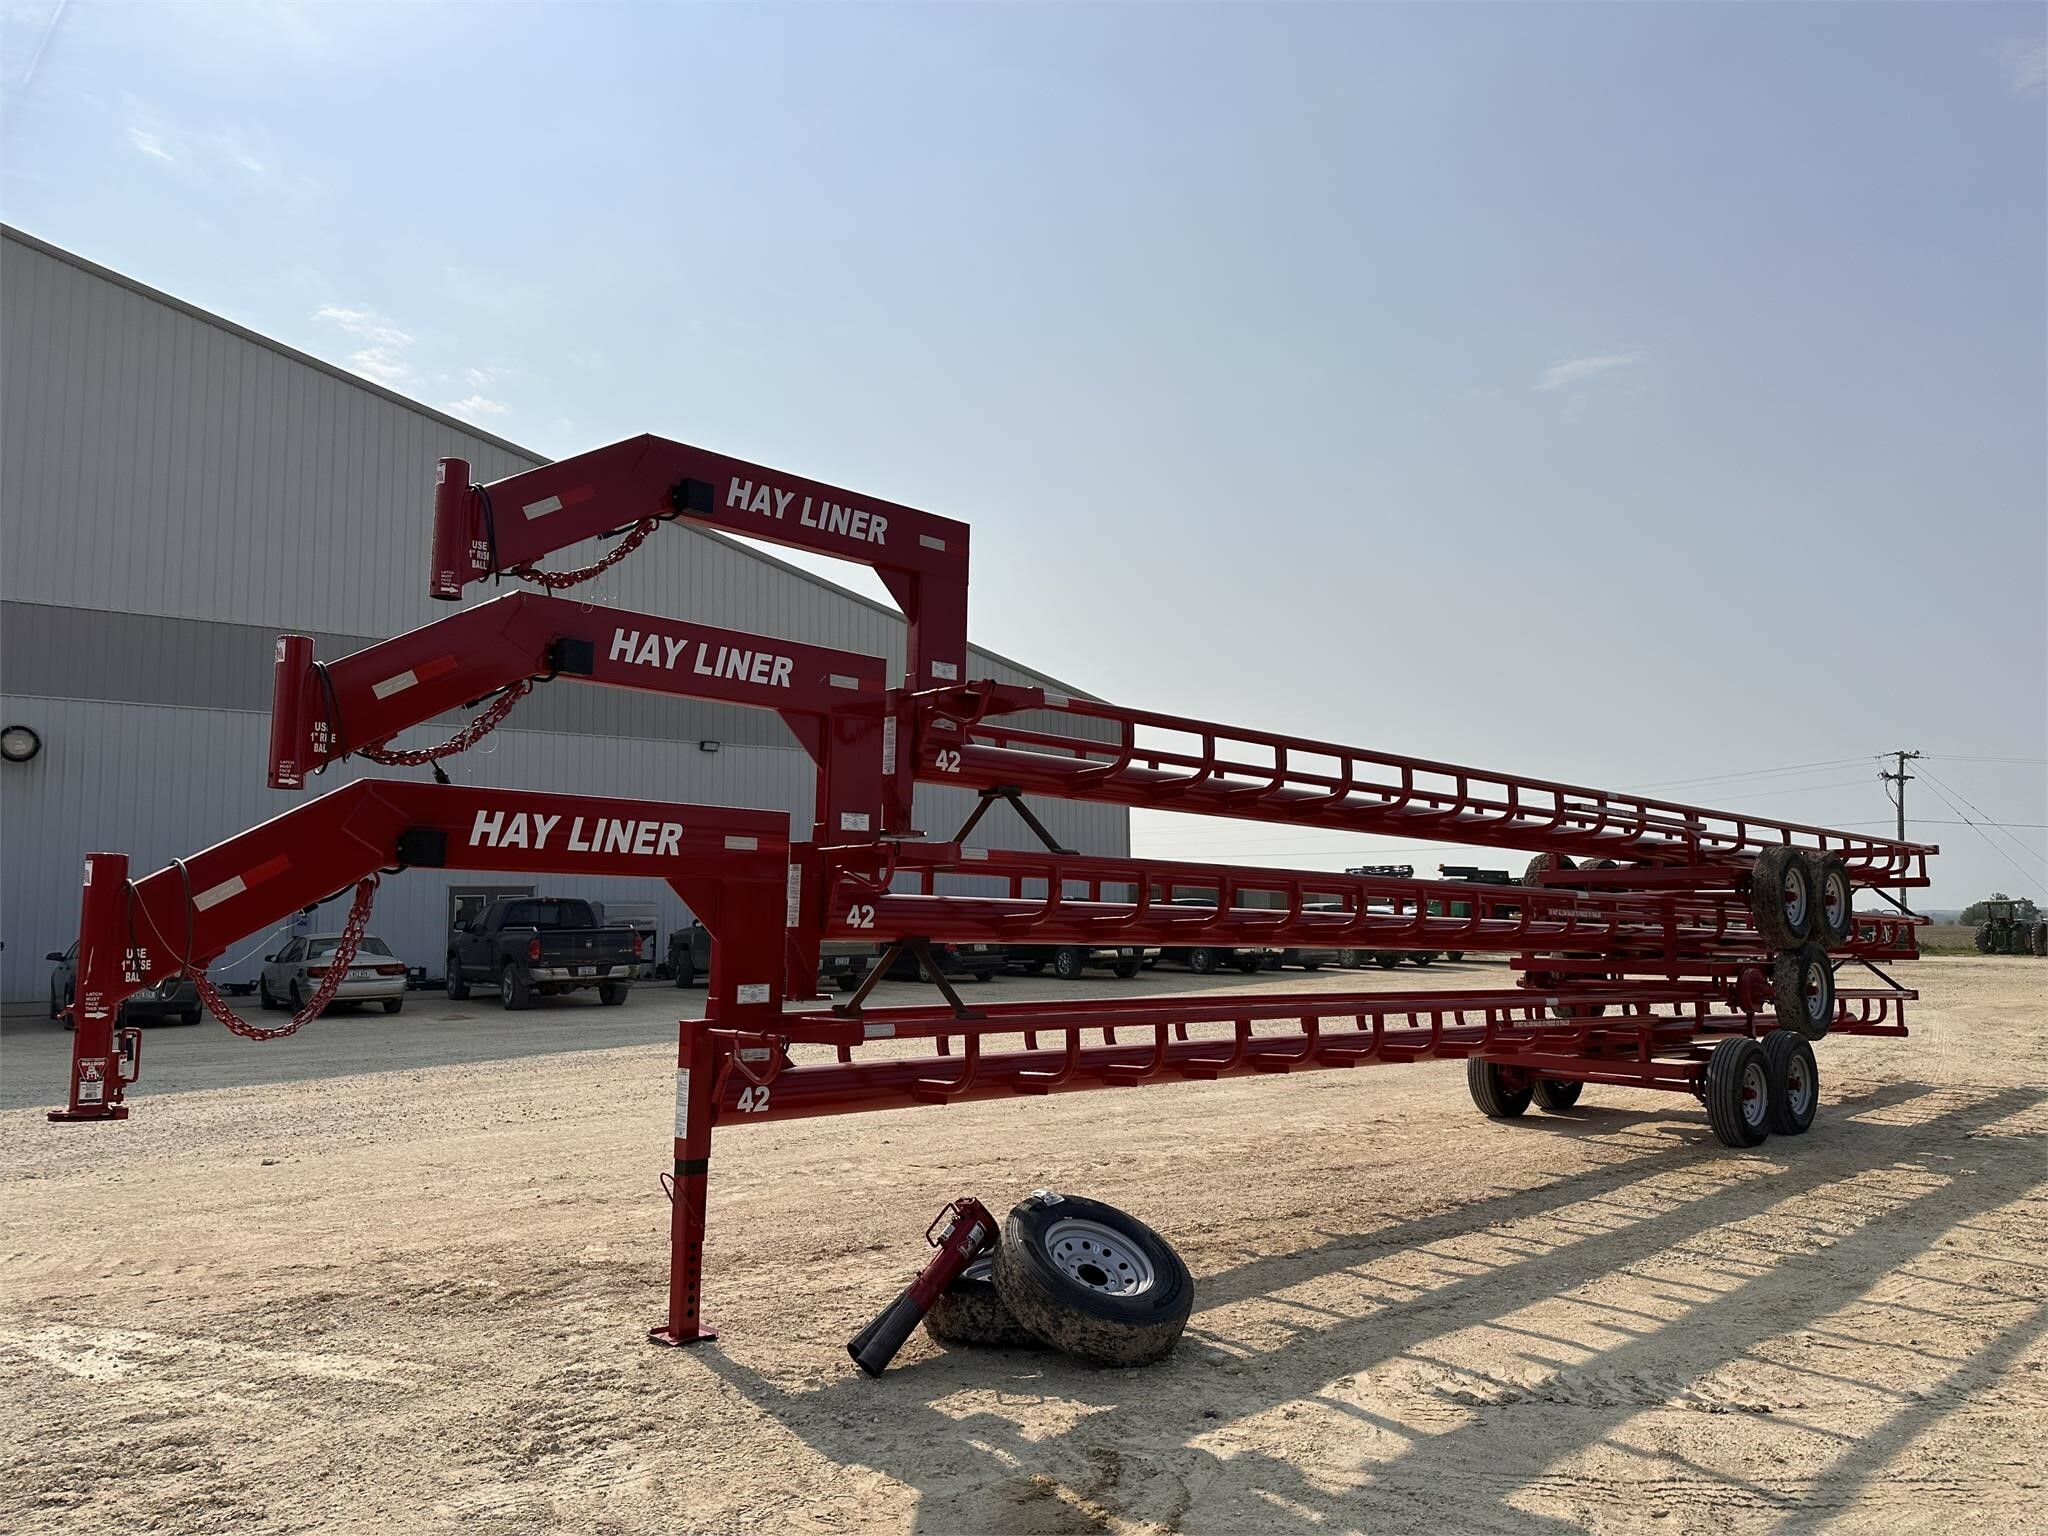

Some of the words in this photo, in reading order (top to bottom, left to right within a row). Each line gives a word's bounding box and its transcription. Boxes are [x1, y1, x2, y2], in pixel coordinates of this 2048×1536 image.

[726, 476, 796, 519] HAY
[800, 496, 888, 545] LINER
[471, 540, 488, 551] USE
[471, 559, 488, 570] BALL
[608, 627, 689, 670] HAY
[693, 642, 794, 688] LINER
[314, 721, 329, 732] US
[319, 732, 337, 743] RIE
[935, 749, 961, 773] 42
[468, 810, 562, 850] HAY
[567, 816, 683, 856] LINER
[846, 904, 875, 928] 42
[736, 1086, 770, 1113] 42
